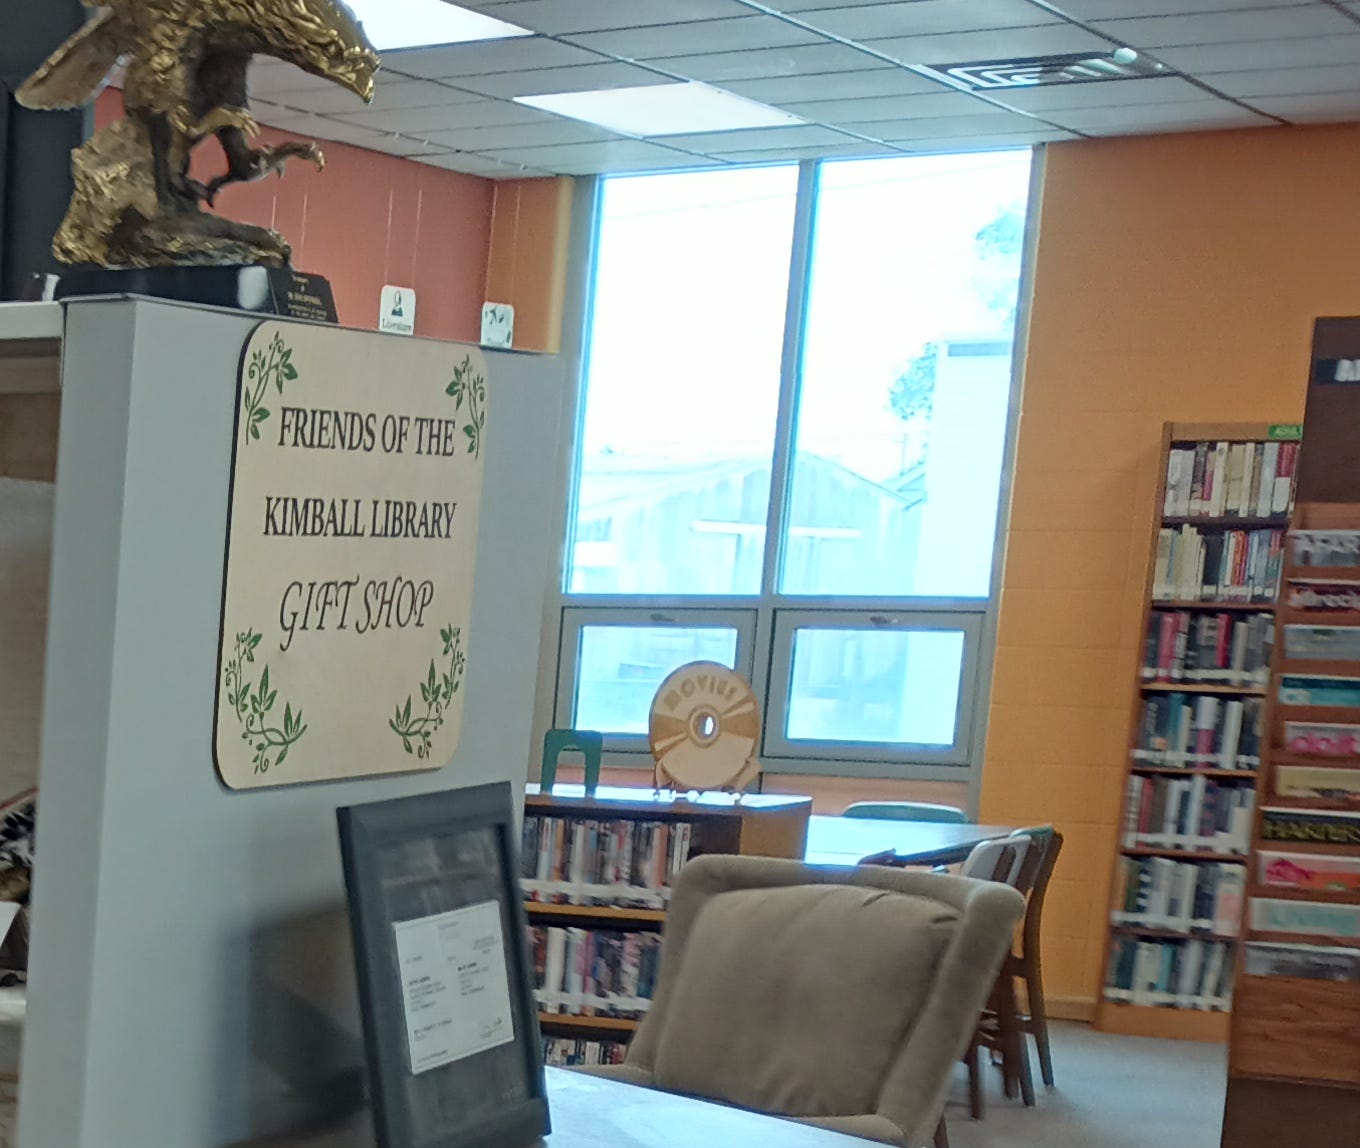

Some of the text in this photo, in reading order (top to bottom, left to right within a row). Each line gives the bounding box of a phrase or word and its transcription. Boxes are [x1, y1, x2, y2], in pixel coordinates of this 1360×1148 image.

[278, 406, 456, 457] FRIENDS OF THE
[263, 496, 457, 539] KIMBALL LIBRARY
[279, 573, 435, 652] GIFT SHOP
